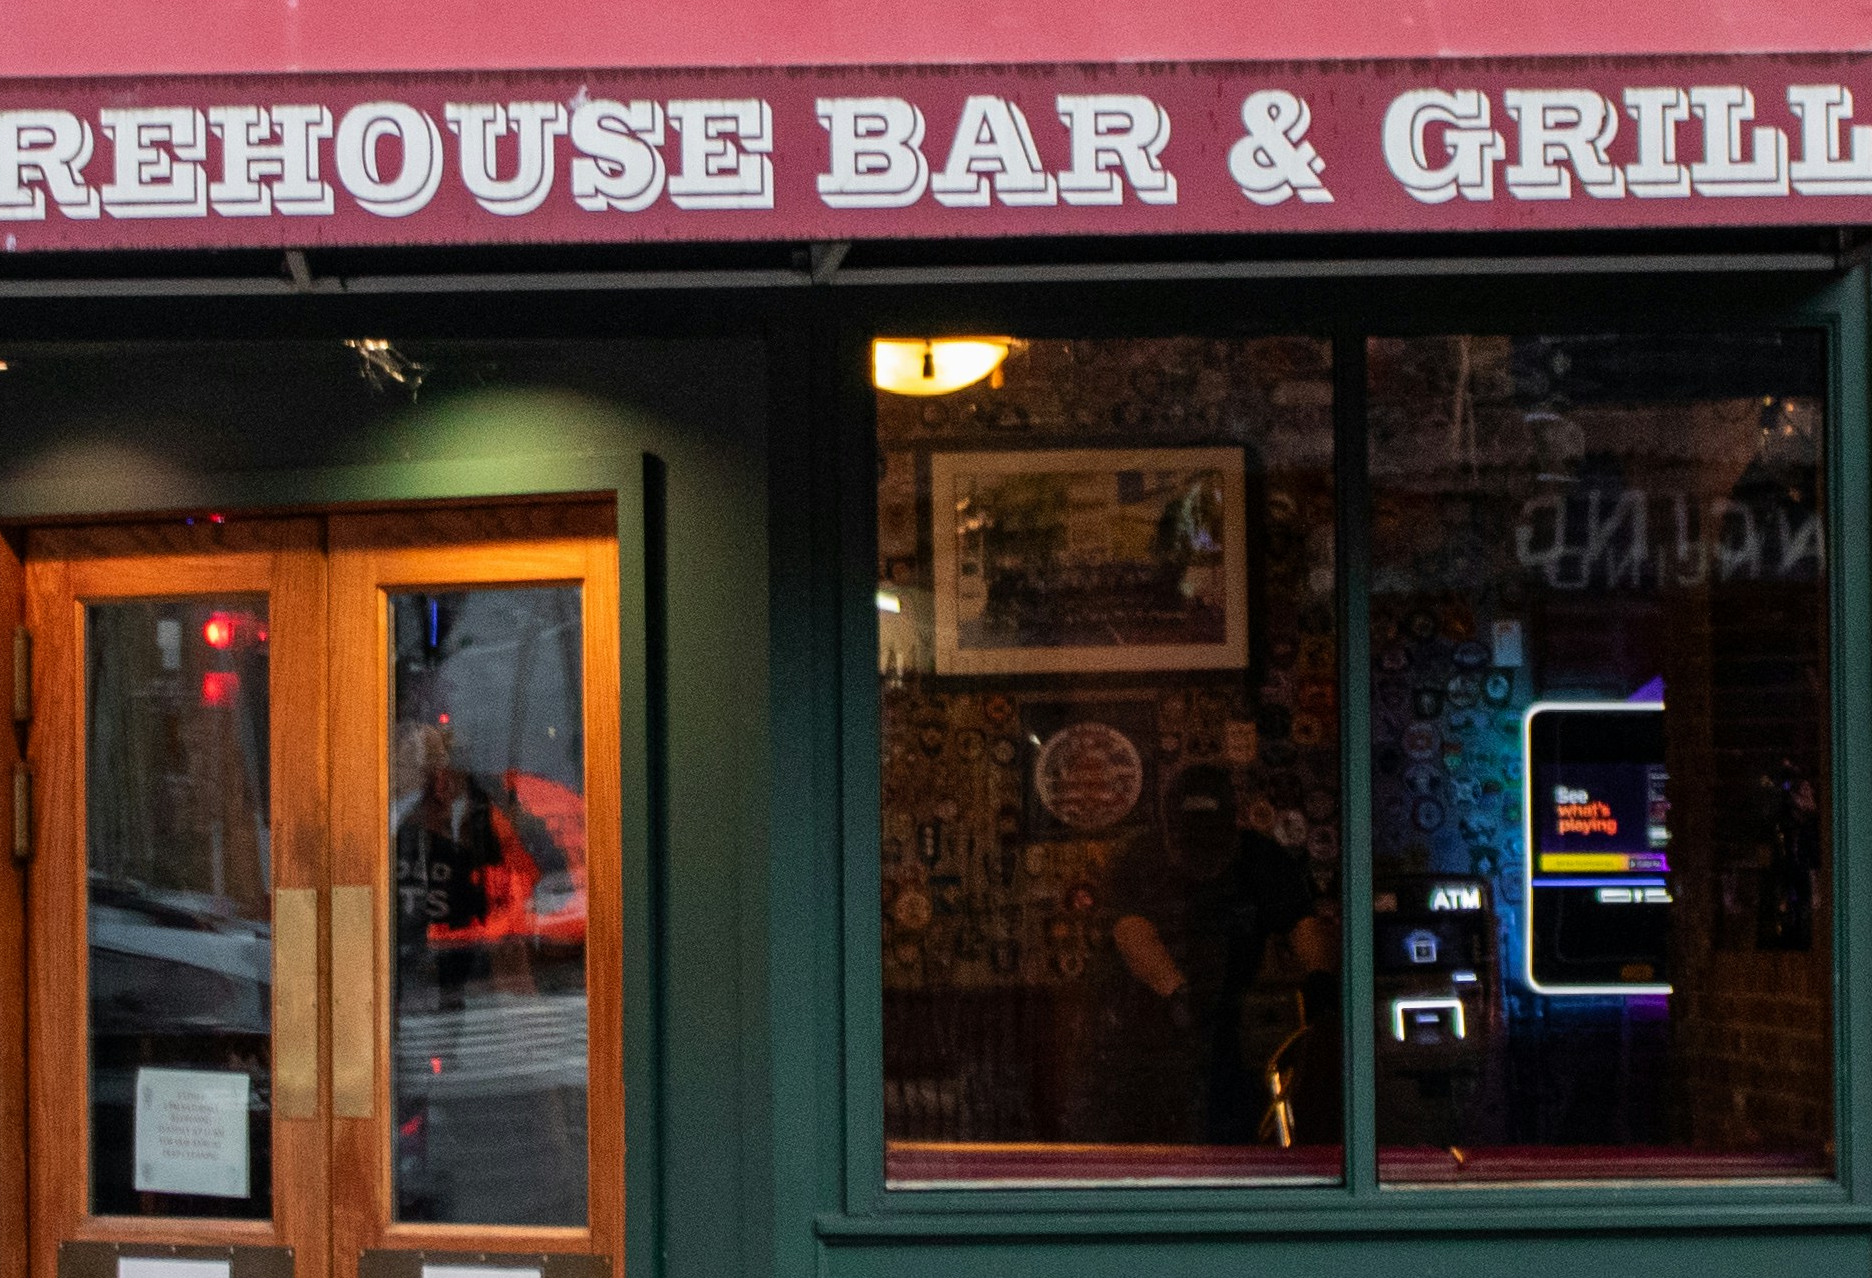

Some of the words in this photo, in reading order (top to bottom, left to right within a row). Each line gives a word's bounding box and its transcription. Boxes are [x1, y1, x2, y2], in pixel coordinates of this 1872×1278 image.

[815, 92, 1177, 208] BAR
[1228, 88, 1333, 204] &
[1553, 784, 1589, 804] See
[1556, 801, 1611, 817] what's
[1557, 818, 1619, 837] playing
[1431, 886, 1482, 911] ATM
